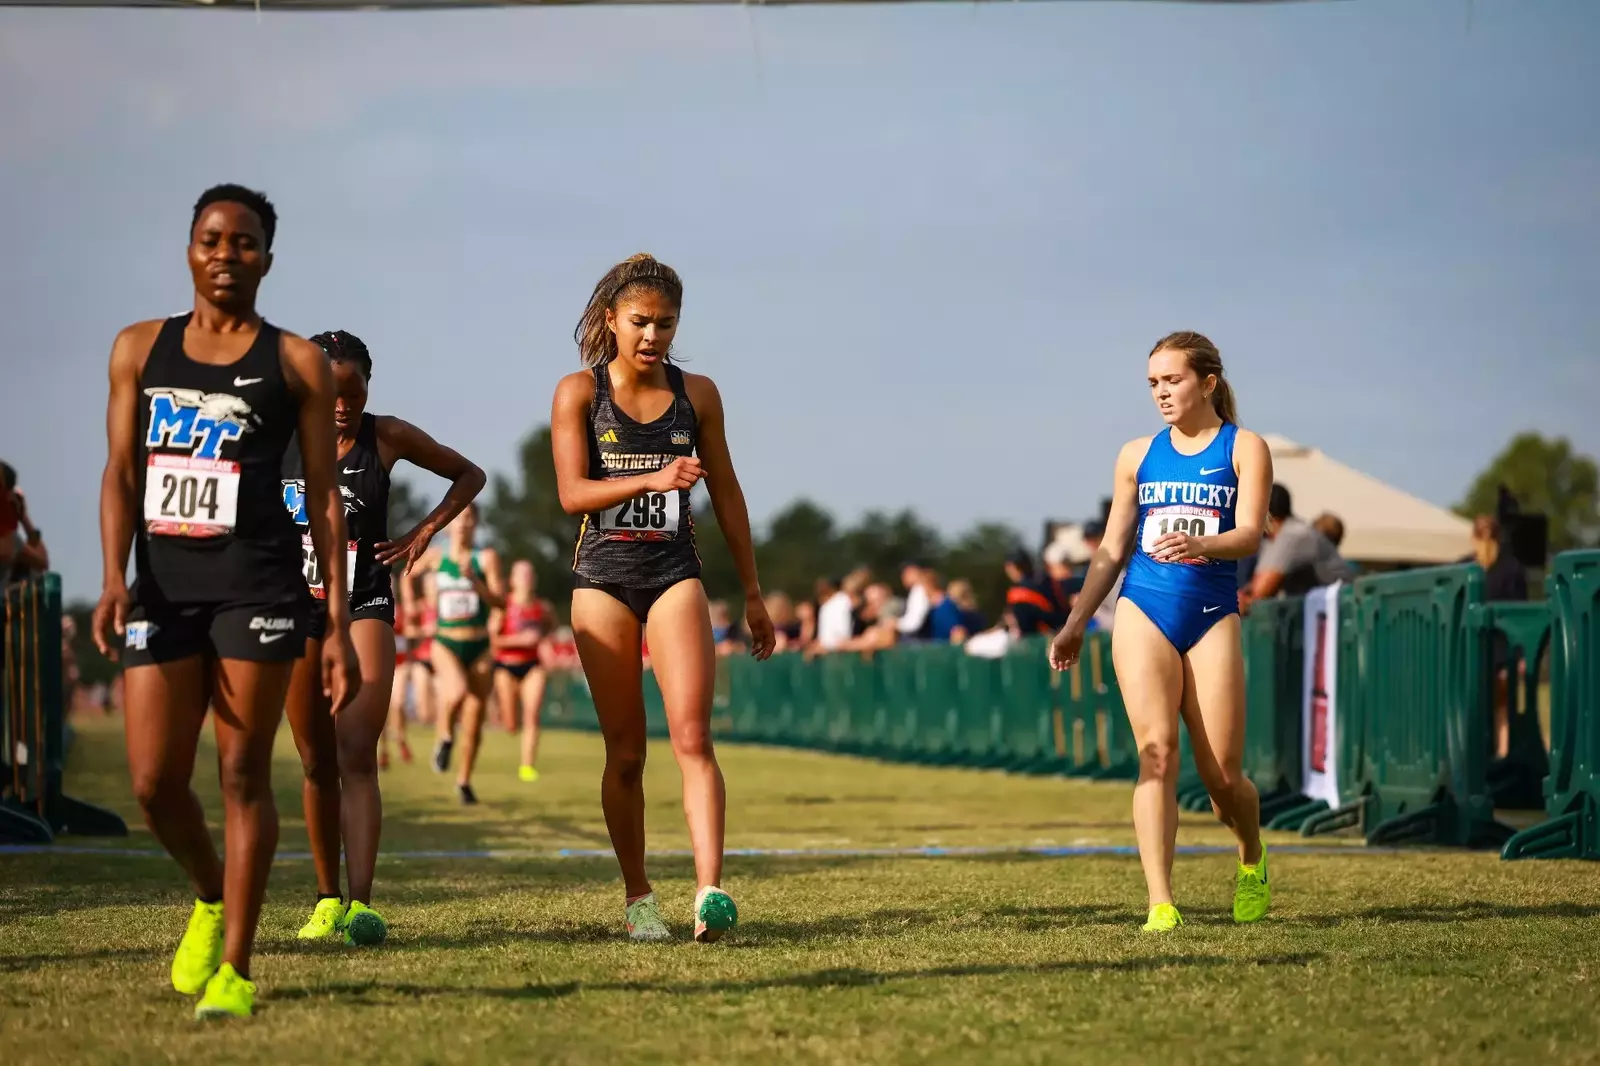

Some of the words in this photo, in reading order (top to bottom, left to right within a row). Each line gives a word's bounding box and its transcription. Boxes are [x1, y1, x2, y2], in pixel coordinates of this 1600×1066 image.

[146, 393, 243, 461] MT
[601, 452, 660, 469] SOUTHERN
[161, 474, 219, 520] 204
[615, 493, 667, 529] 293
[1139, 481, 1236, 509] KENTUCKY
